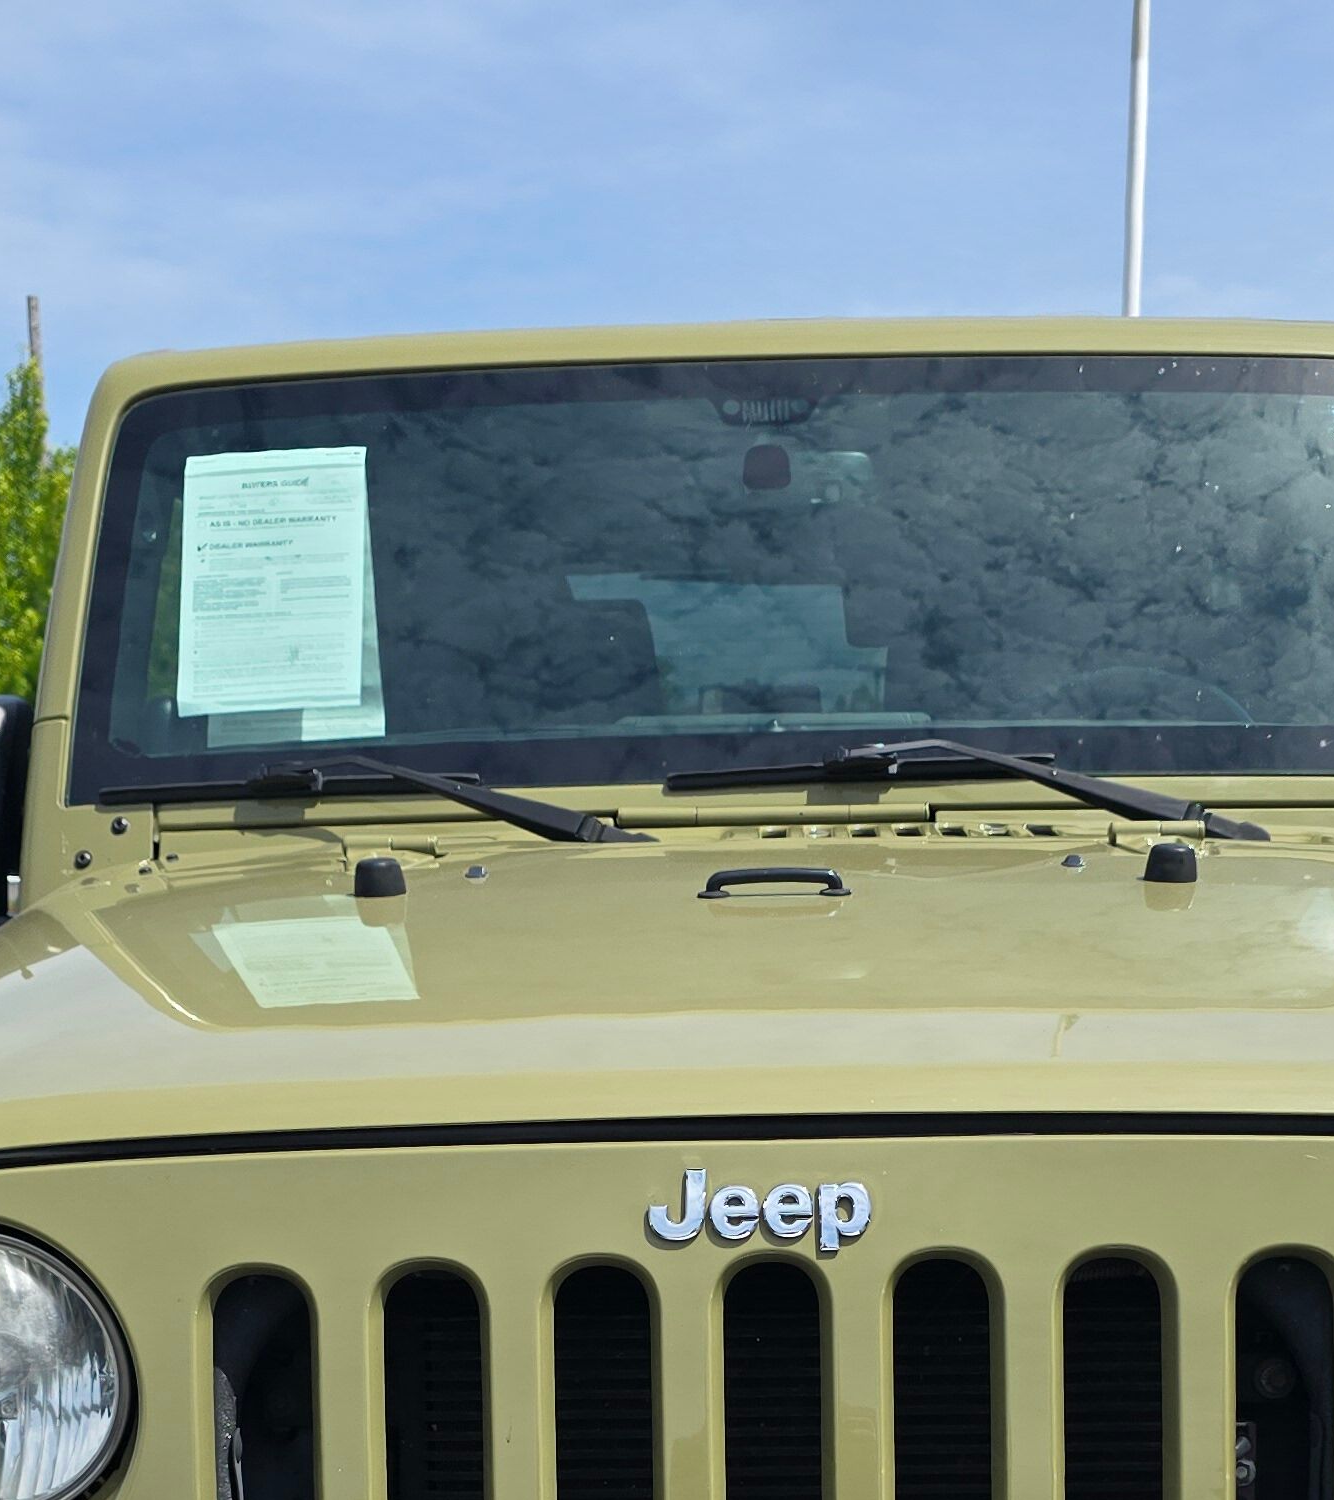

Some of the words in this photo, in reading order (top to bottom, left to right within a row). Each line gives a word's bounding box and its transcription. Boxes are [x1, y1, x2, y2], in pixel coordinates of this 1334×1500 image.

[282, 477, 309, 488] GUIDE
[238, 519, 250, 527] NO
[252, 517, 287, 526] DEALER
[288, 515, 337, 524] WARRANTY
[209, 542, 244, 550] DEALER
[245, 539, 294, 549] WARRANTY
[648, 1168, 873, 1252] Jeep
